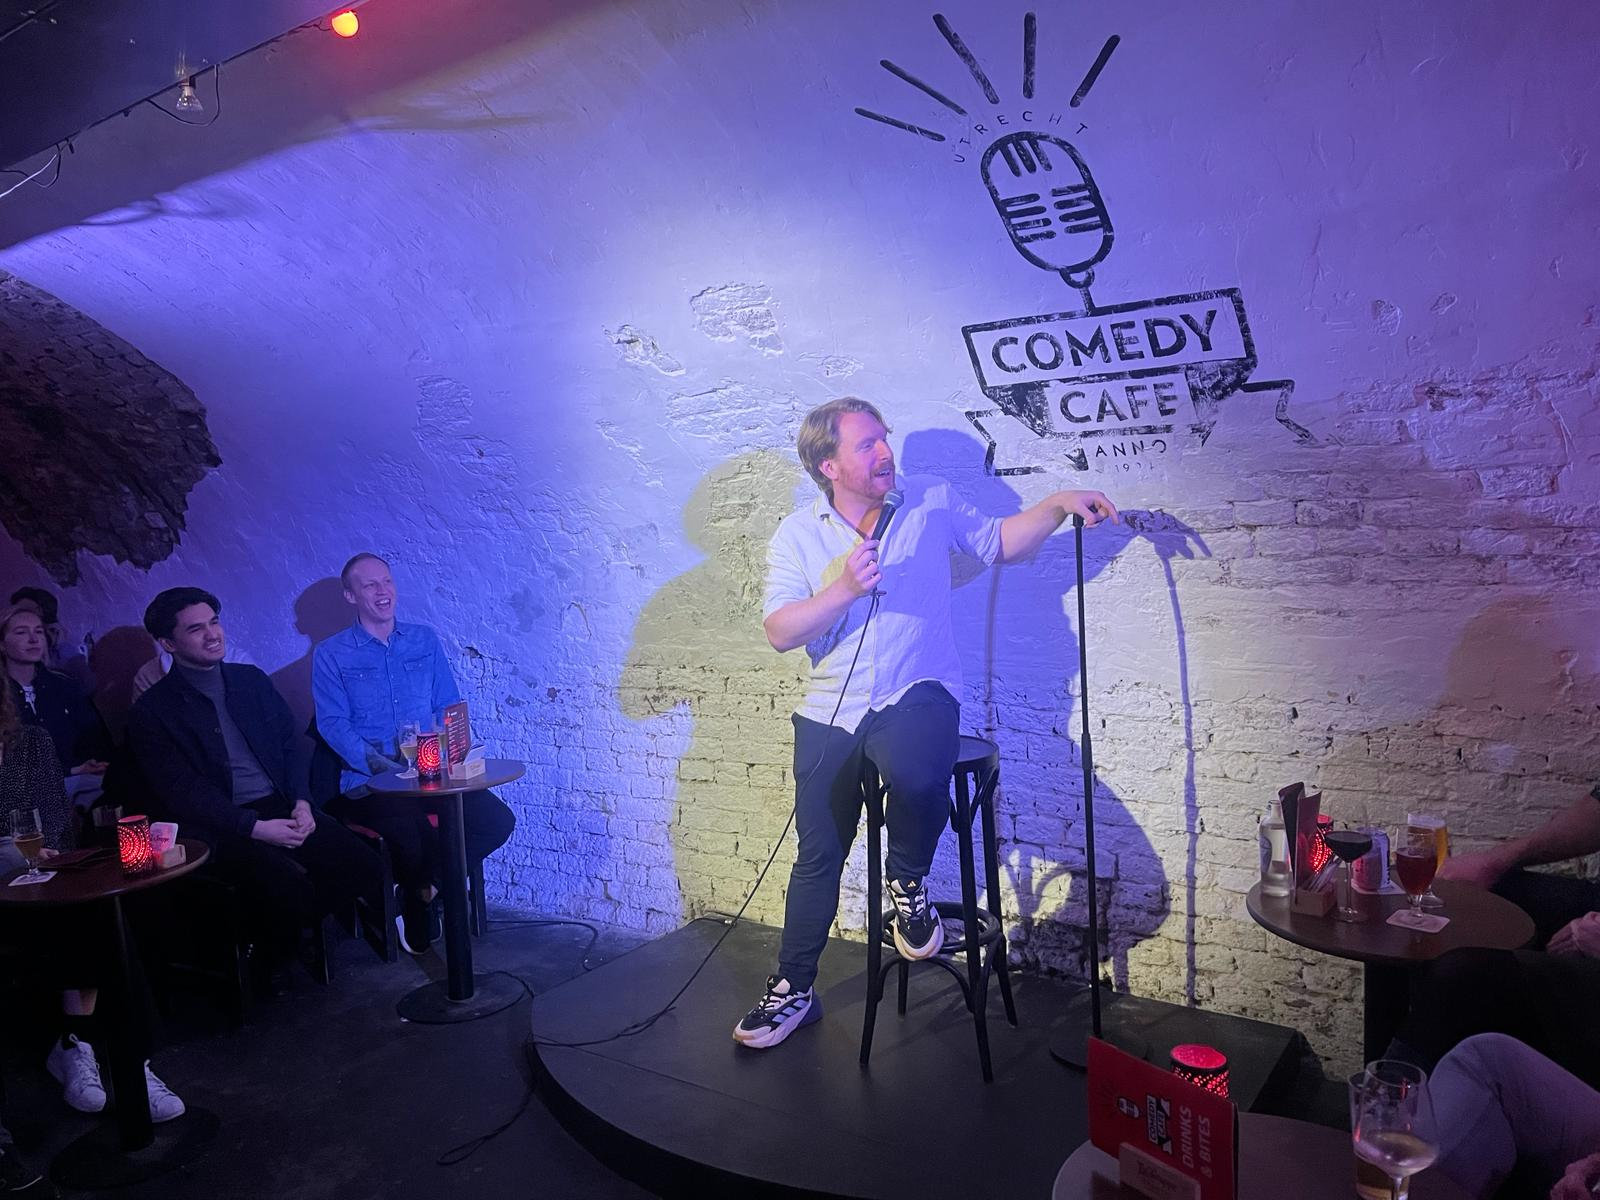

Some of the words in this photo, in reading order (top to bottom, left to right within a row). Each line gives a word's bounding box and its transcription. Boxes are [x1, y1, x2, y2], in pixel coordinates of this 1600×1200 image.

[952, 110, 1088, 163] UTRECHT
[992, 310, 1217, 373] COMEDY
[1059, 382, 1176, 424] CAFE
[1095, 439, 1167, 457] ANNO
[1179, 1105, 1194, 1168] DRINKS
[1198, 1114, 1211, 1162] BITES
